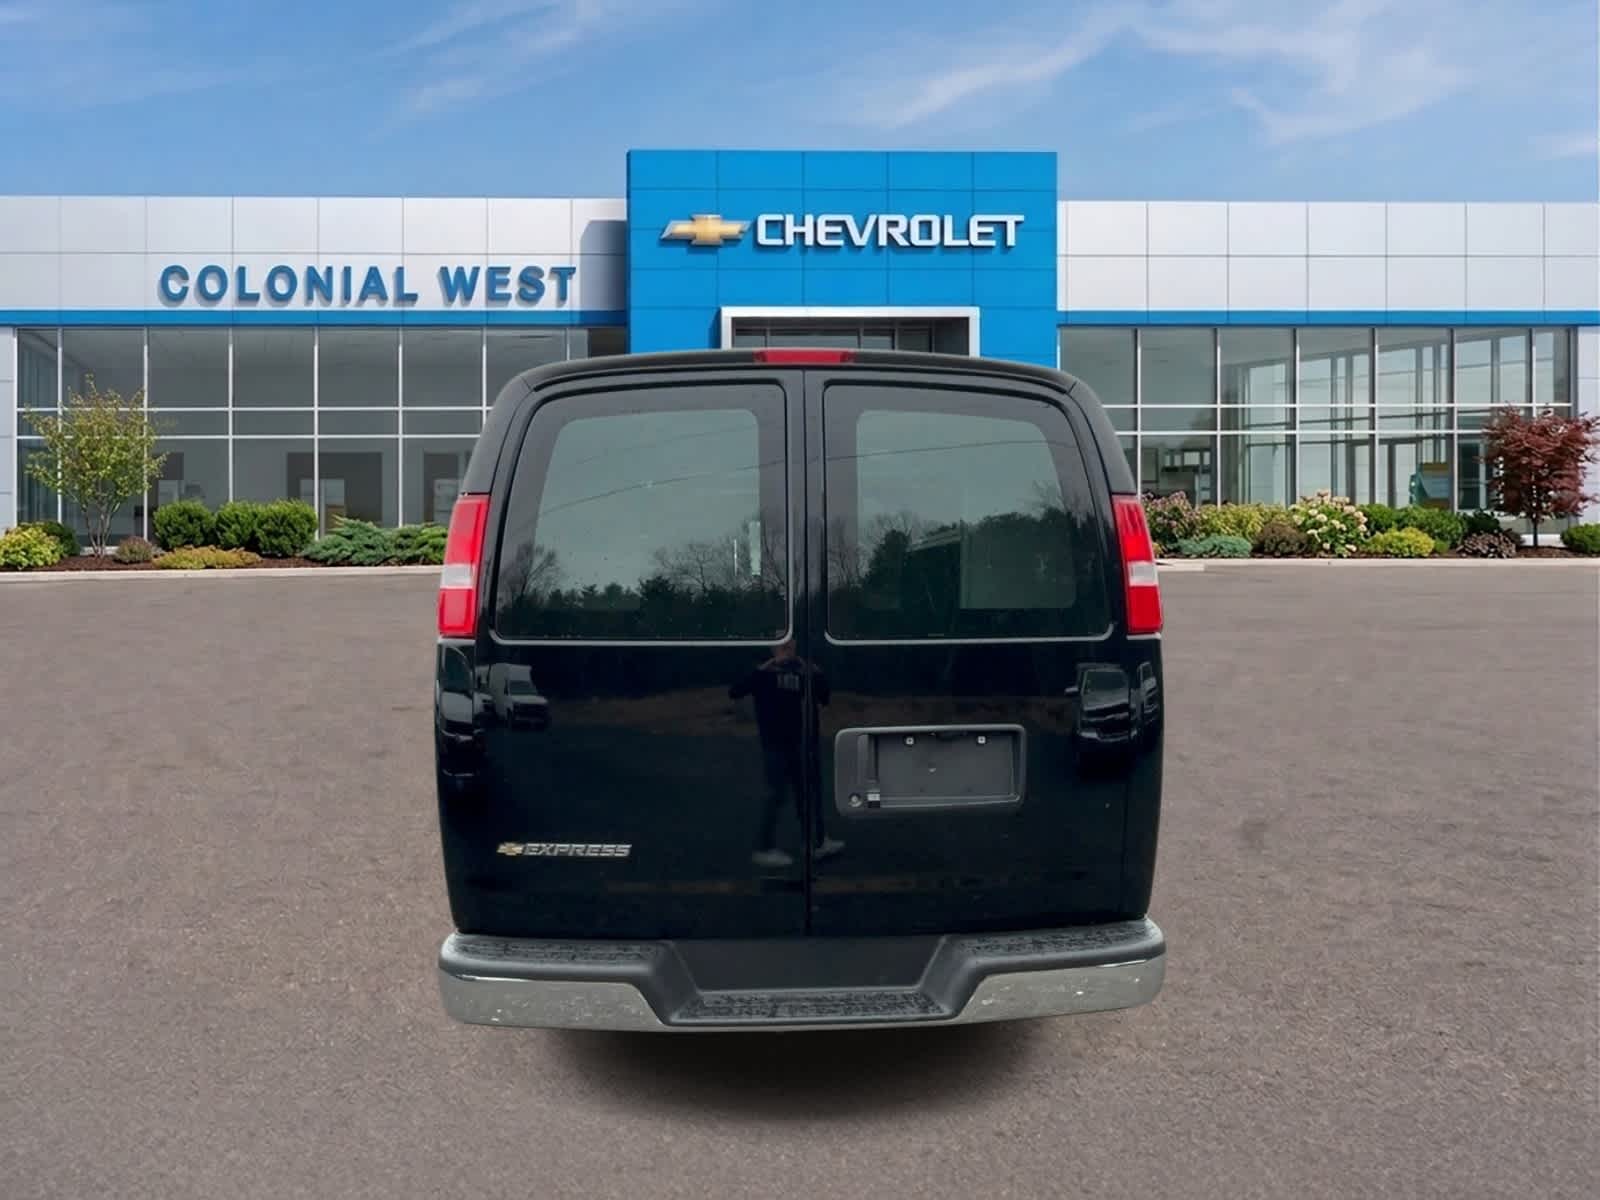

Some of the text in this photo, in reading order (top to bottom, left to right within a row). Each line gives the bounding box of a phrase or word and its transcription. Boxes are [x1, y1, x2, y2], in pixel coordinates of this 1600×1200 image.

[757, 213, 1025, 248] CHEVROLET
[160, 265, 577, 304] COLONIAL WEST
[524, 843, 632, 857] EXPRESS
